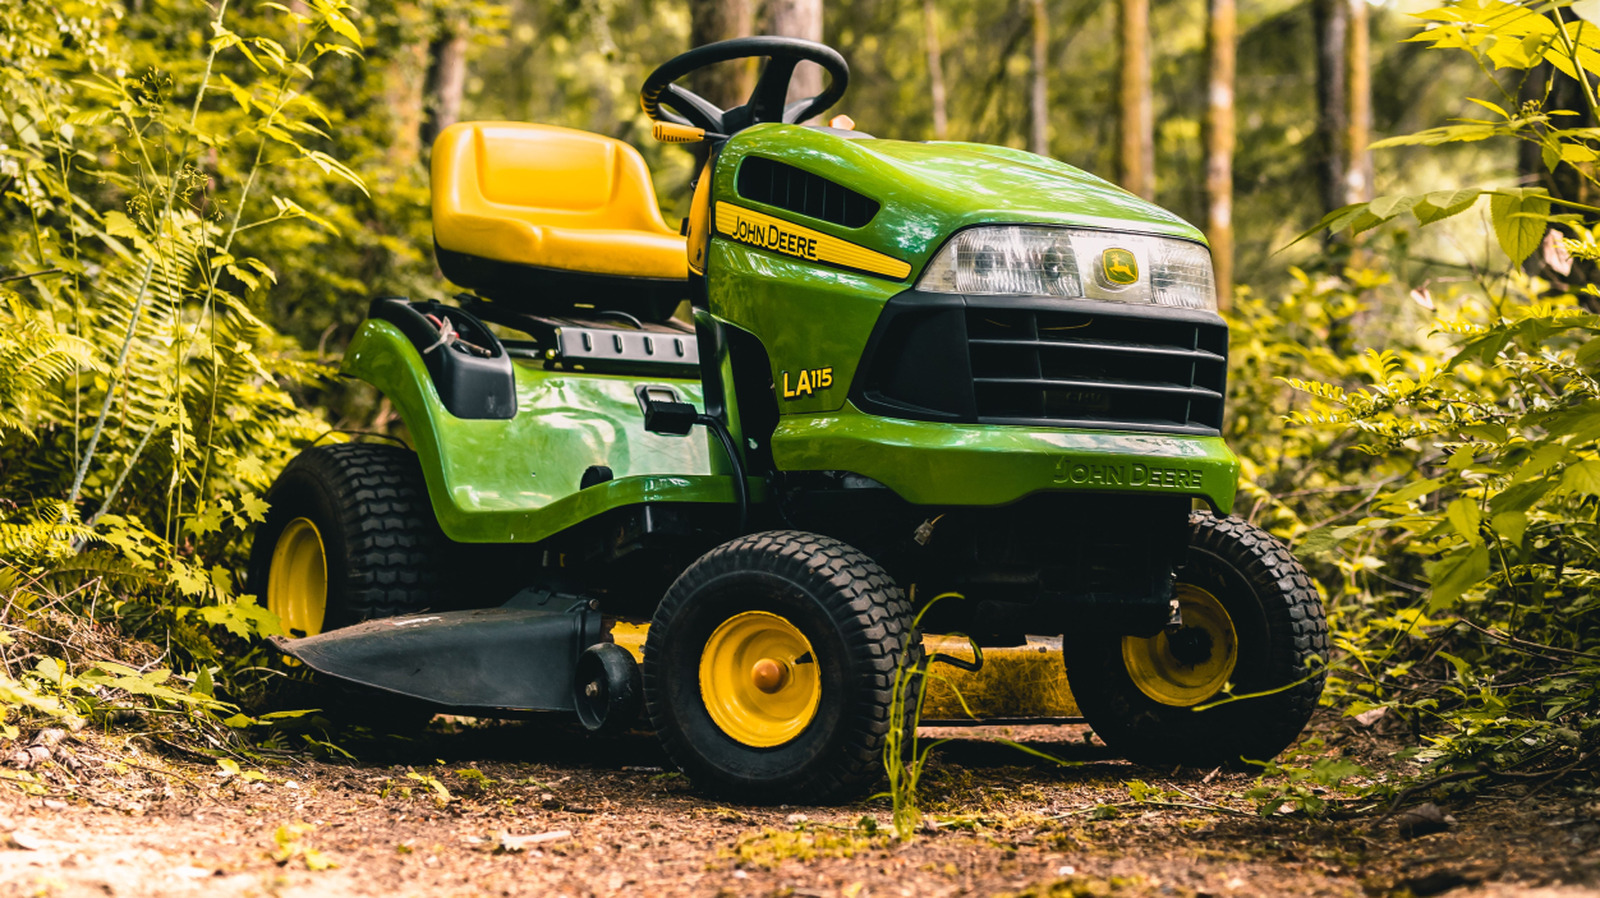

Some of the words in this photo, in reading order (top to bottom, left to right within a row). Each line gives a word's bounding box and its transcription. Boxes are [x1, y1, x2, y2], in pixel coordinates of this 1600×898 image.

[732, 216, 765, 244] JOHN
[768, 225, 817, 257] DEERE
[784, 368, 832, 398] LA115
[1053, 460, 1124, 485] JOHN
[1129, 463, 1202, 488] DEERE
